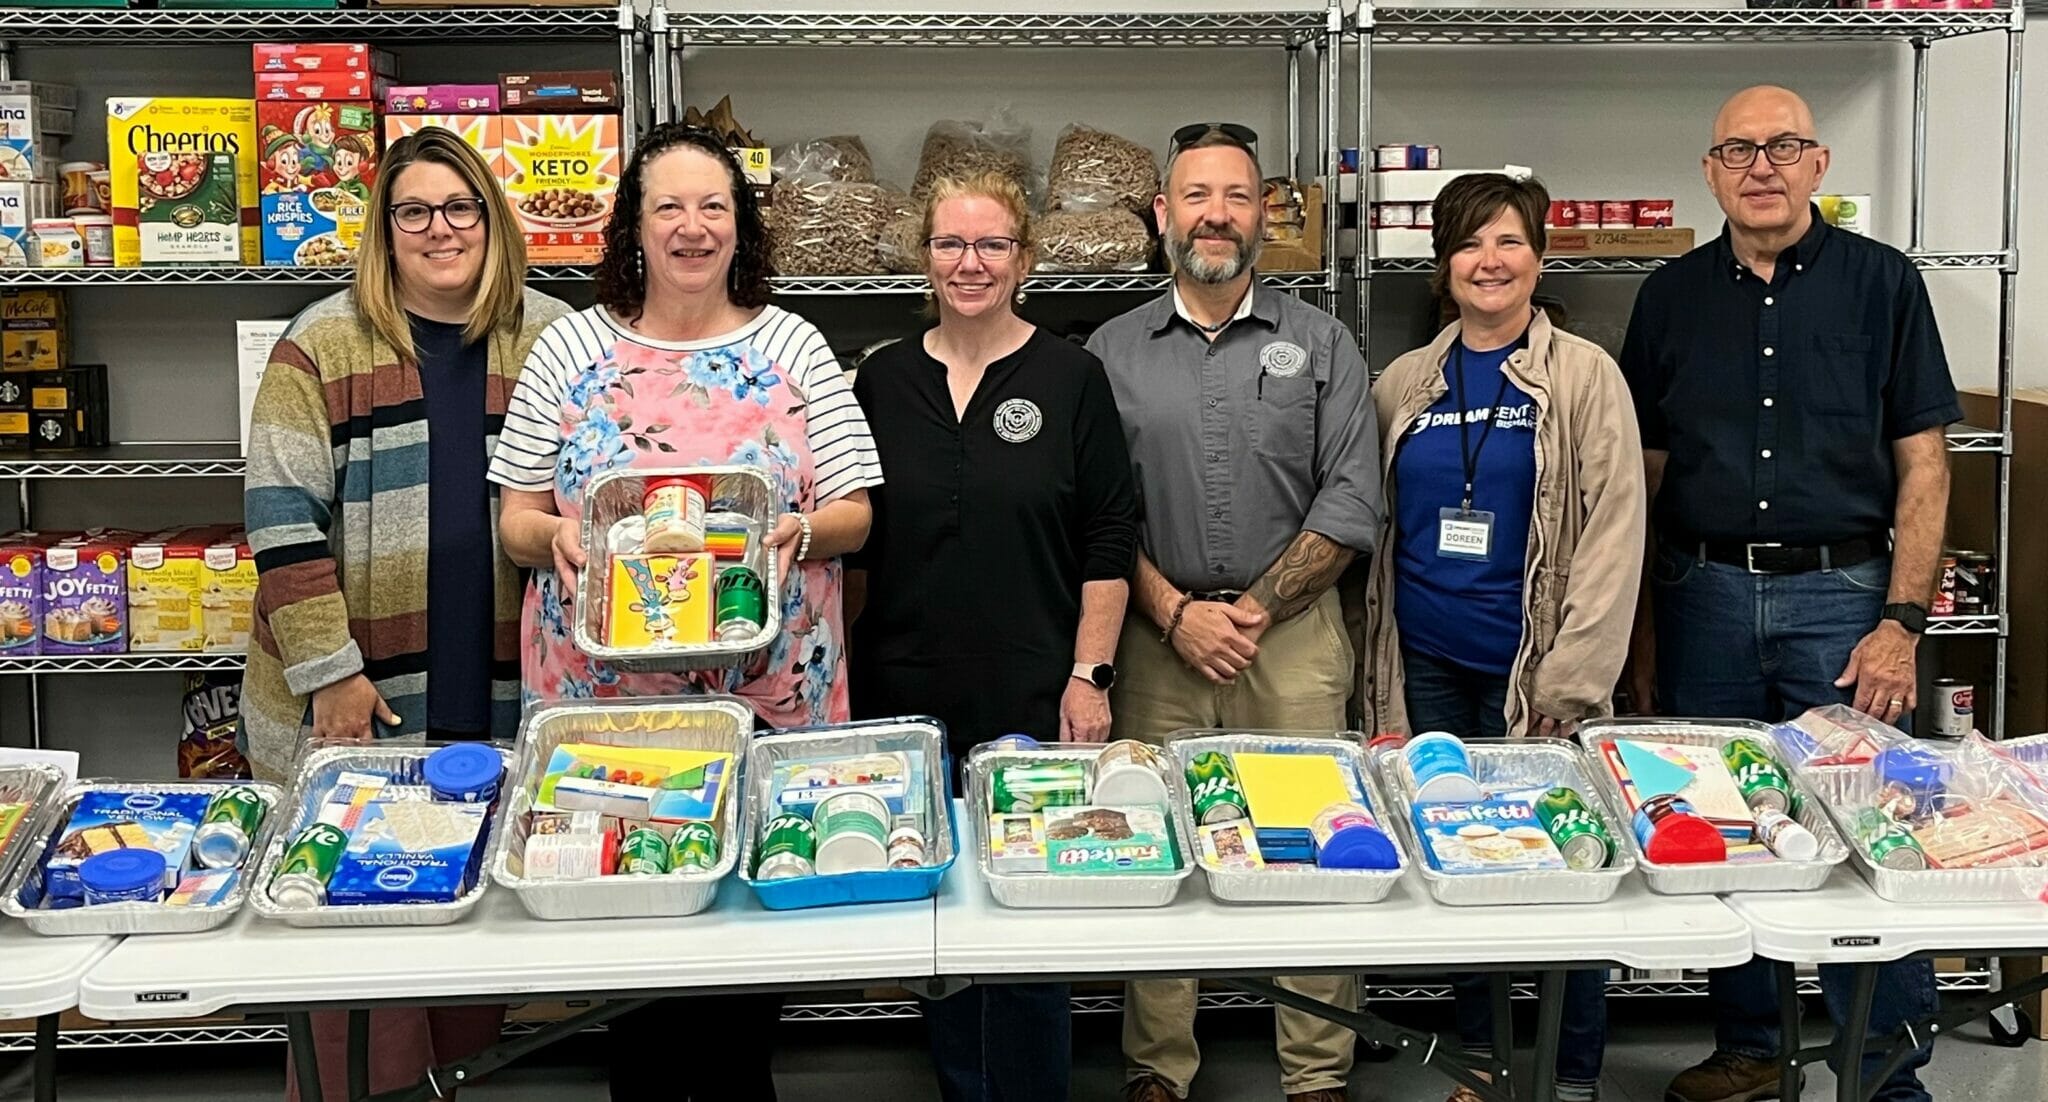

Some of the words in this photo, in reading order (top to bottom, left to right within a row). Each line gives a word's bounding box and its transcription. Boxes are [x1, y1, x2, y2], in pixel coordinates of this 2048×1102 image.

[127, 124, 240, 154] Cheerios
[751, 151, 764, 165] 40
[532, 159, 589, 176] KETO
[277, 202, 303, 213] RICE
[338, 206, 364, 215] FREE
[267, 212, 314, 224] KRISPIES
[1446, 533, 1484, 544] DOREEN
[92, 808, 185, 818] TRADITIONAL
[1422, 804, 1531, 823] Funfetti
[1058, 845, 1162, 865] Funfetti
[356, 859, 449, 867] TRADITIONAL
[141, 993, 181, 1001] LIFETIME
